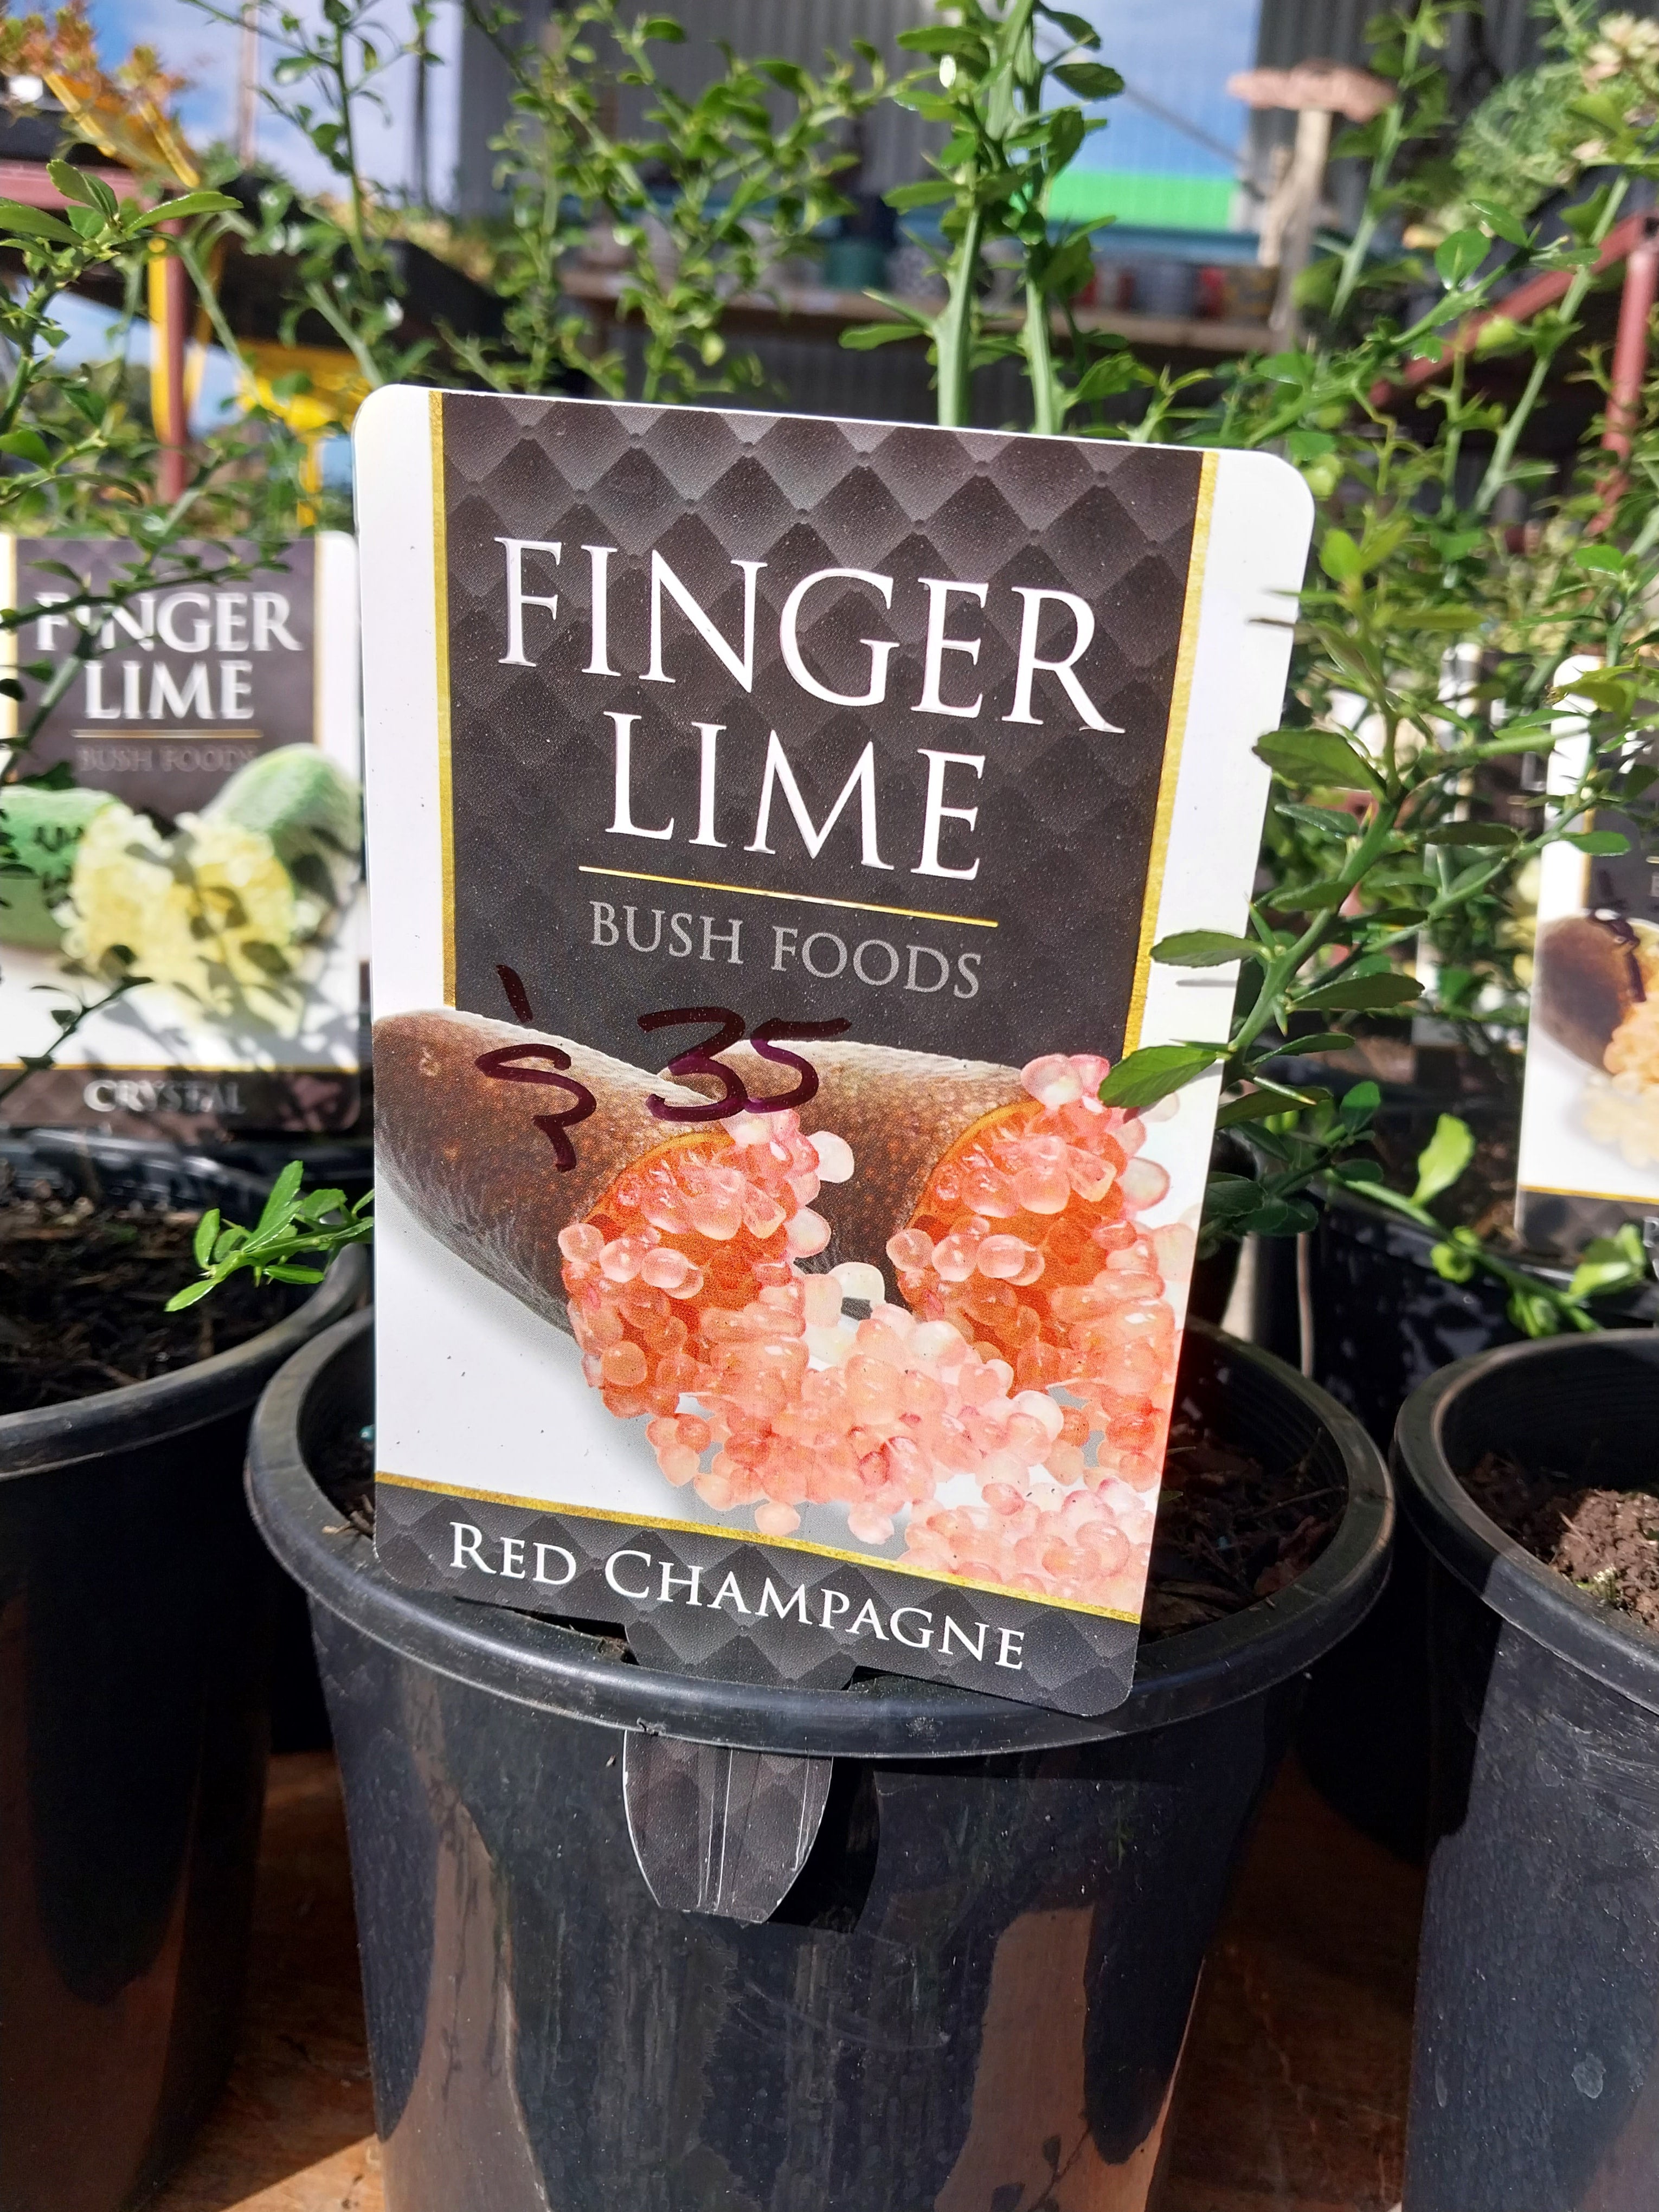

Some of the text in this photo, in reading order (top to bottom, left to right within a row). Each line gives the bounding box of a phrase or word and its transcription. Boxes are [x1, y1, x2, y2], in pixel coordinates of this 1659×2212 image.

[84, 660, 255, 719] LIME
[494, 537, 1125, 734] FINGER
[603, 711, 986, 880] LIME
[589, 901, 982, 999] BUSH FOODS
[449, 1522, 1025, 1670] RED CHAMPAGNE
